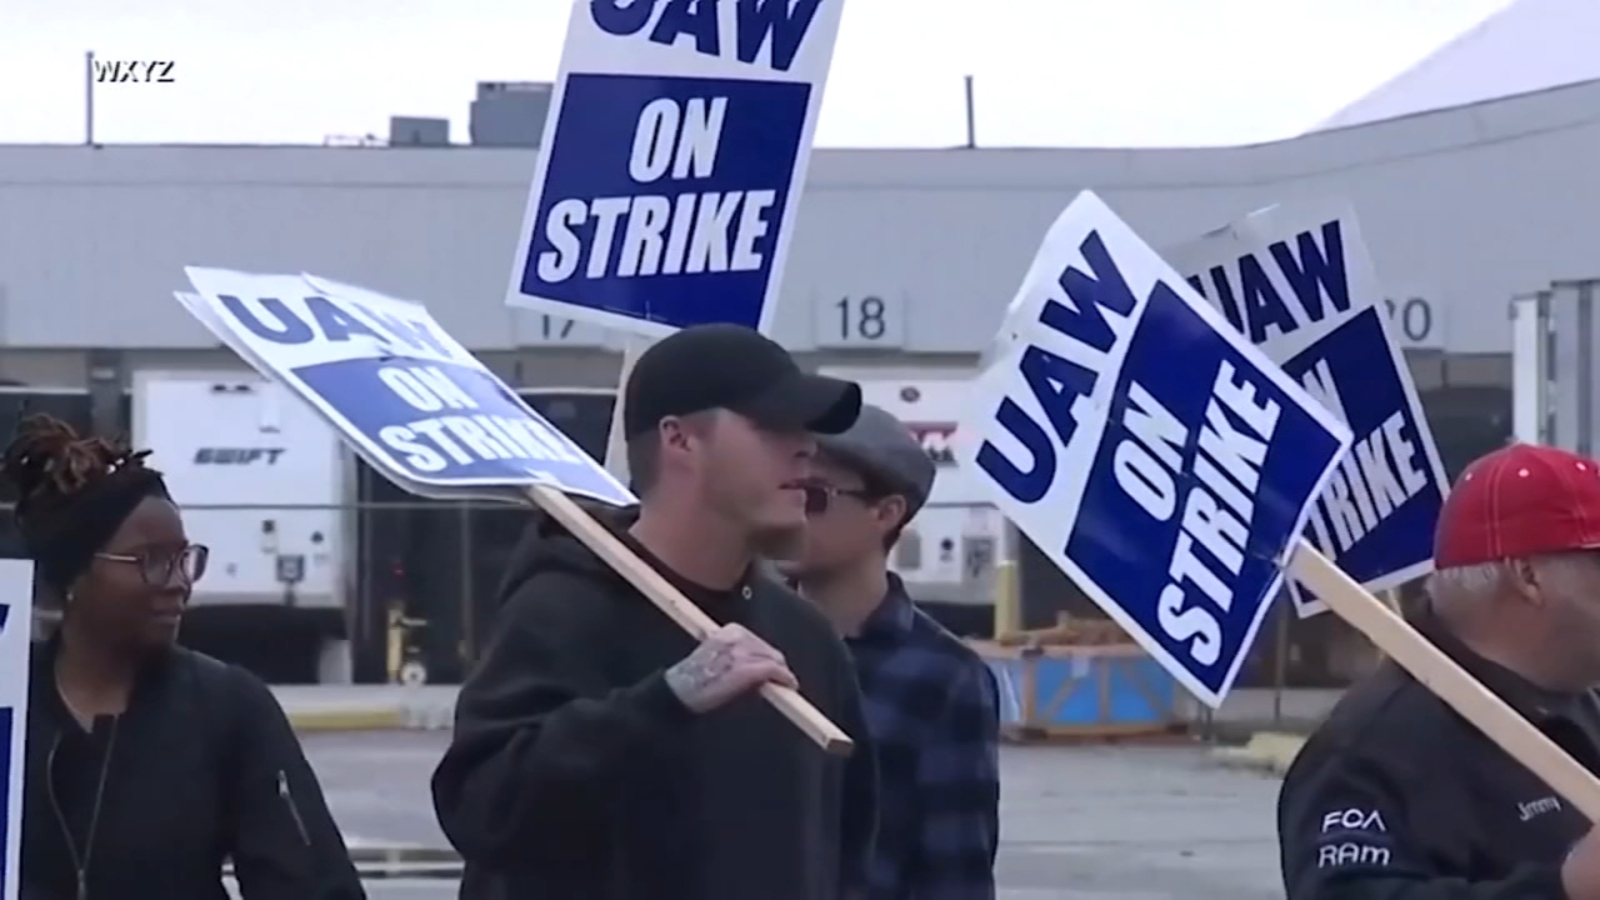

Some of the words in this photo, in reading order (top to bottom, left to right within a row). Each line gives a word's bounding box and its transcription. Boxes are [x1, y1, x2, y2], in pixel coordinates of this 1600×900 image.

[629, 97, 728, 183] ON
[537, 189, 776, 283] STRIKE
[217, 294, 453, 358] UAW
[837, 297, 886, 339] 18
[377, 366, 480, 412] ON
[975, 229, 1138, 504] UAW
[379, 414, 583, 472] STRIKE
[1112, 380, 1190, 522] ON
[1307, 410, 1428, 562] RIKE
[1156, 358, 1282, 667] STRIKE
